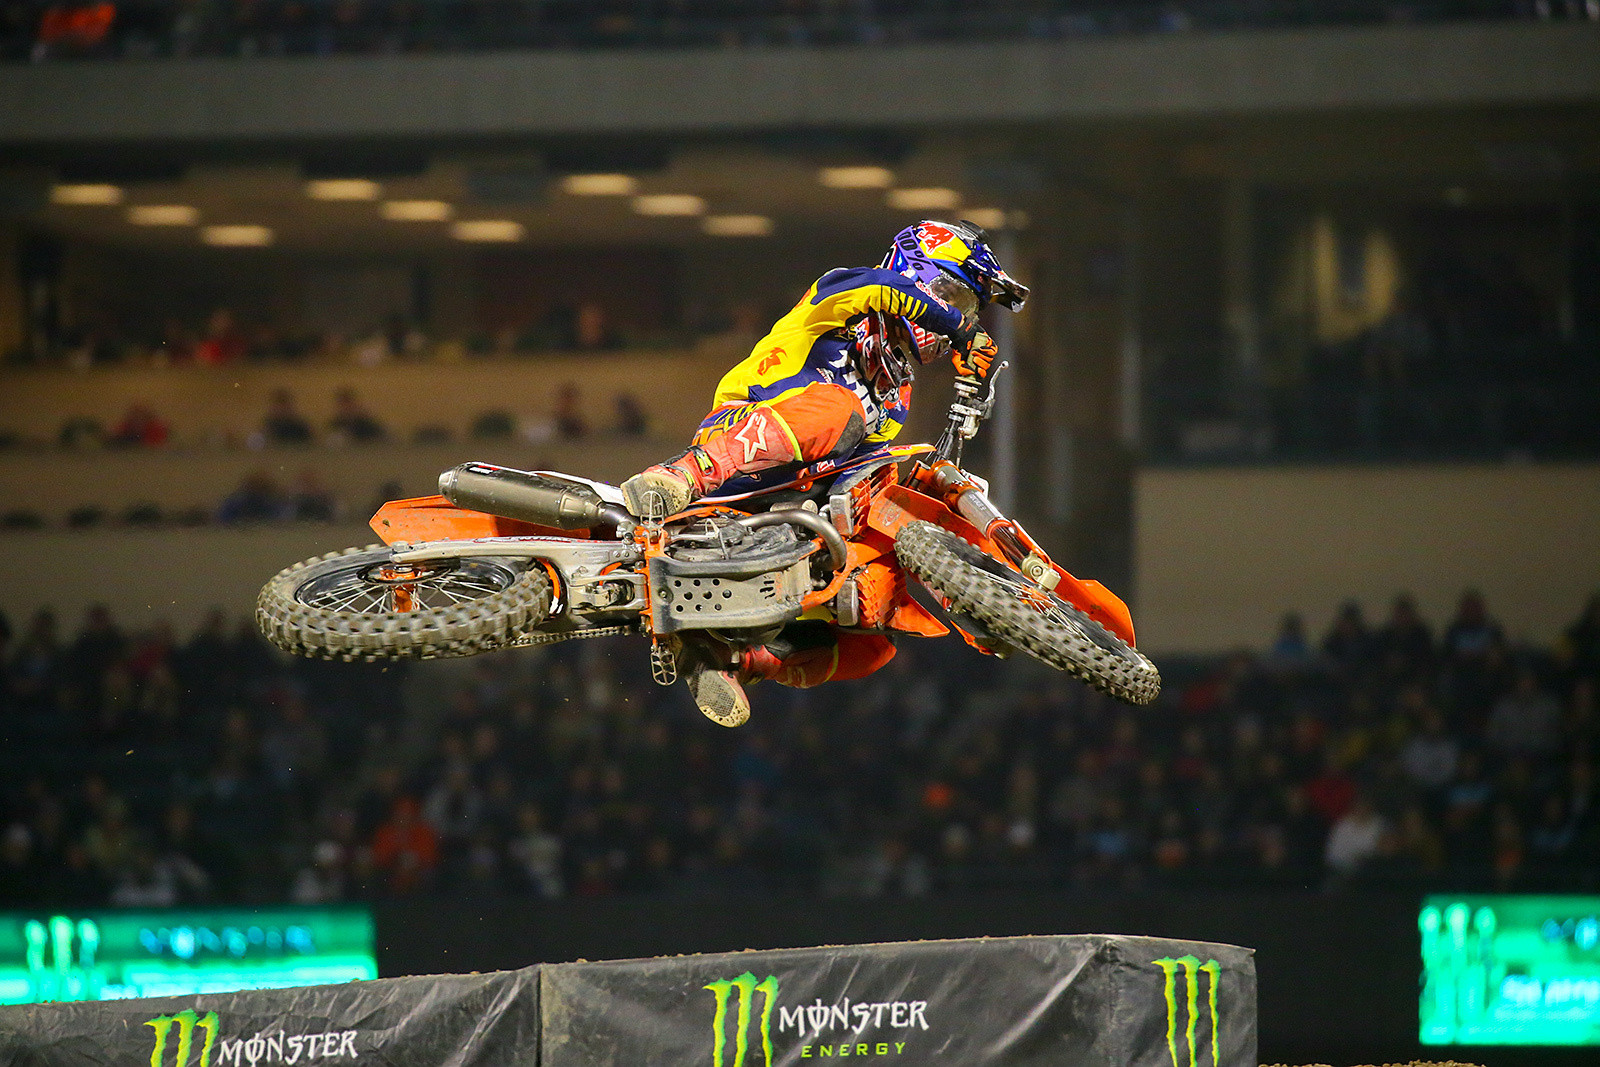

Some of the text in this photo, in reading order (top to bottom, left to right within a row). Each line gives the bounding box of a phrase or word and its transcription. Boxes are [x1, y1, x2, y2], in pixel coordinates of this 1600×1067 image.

[778, 997, 930, 1038] MONSTER
[216, 1029, 359, 1067] MONSTER
[800, 1042, 906, 1058] ENERGY
